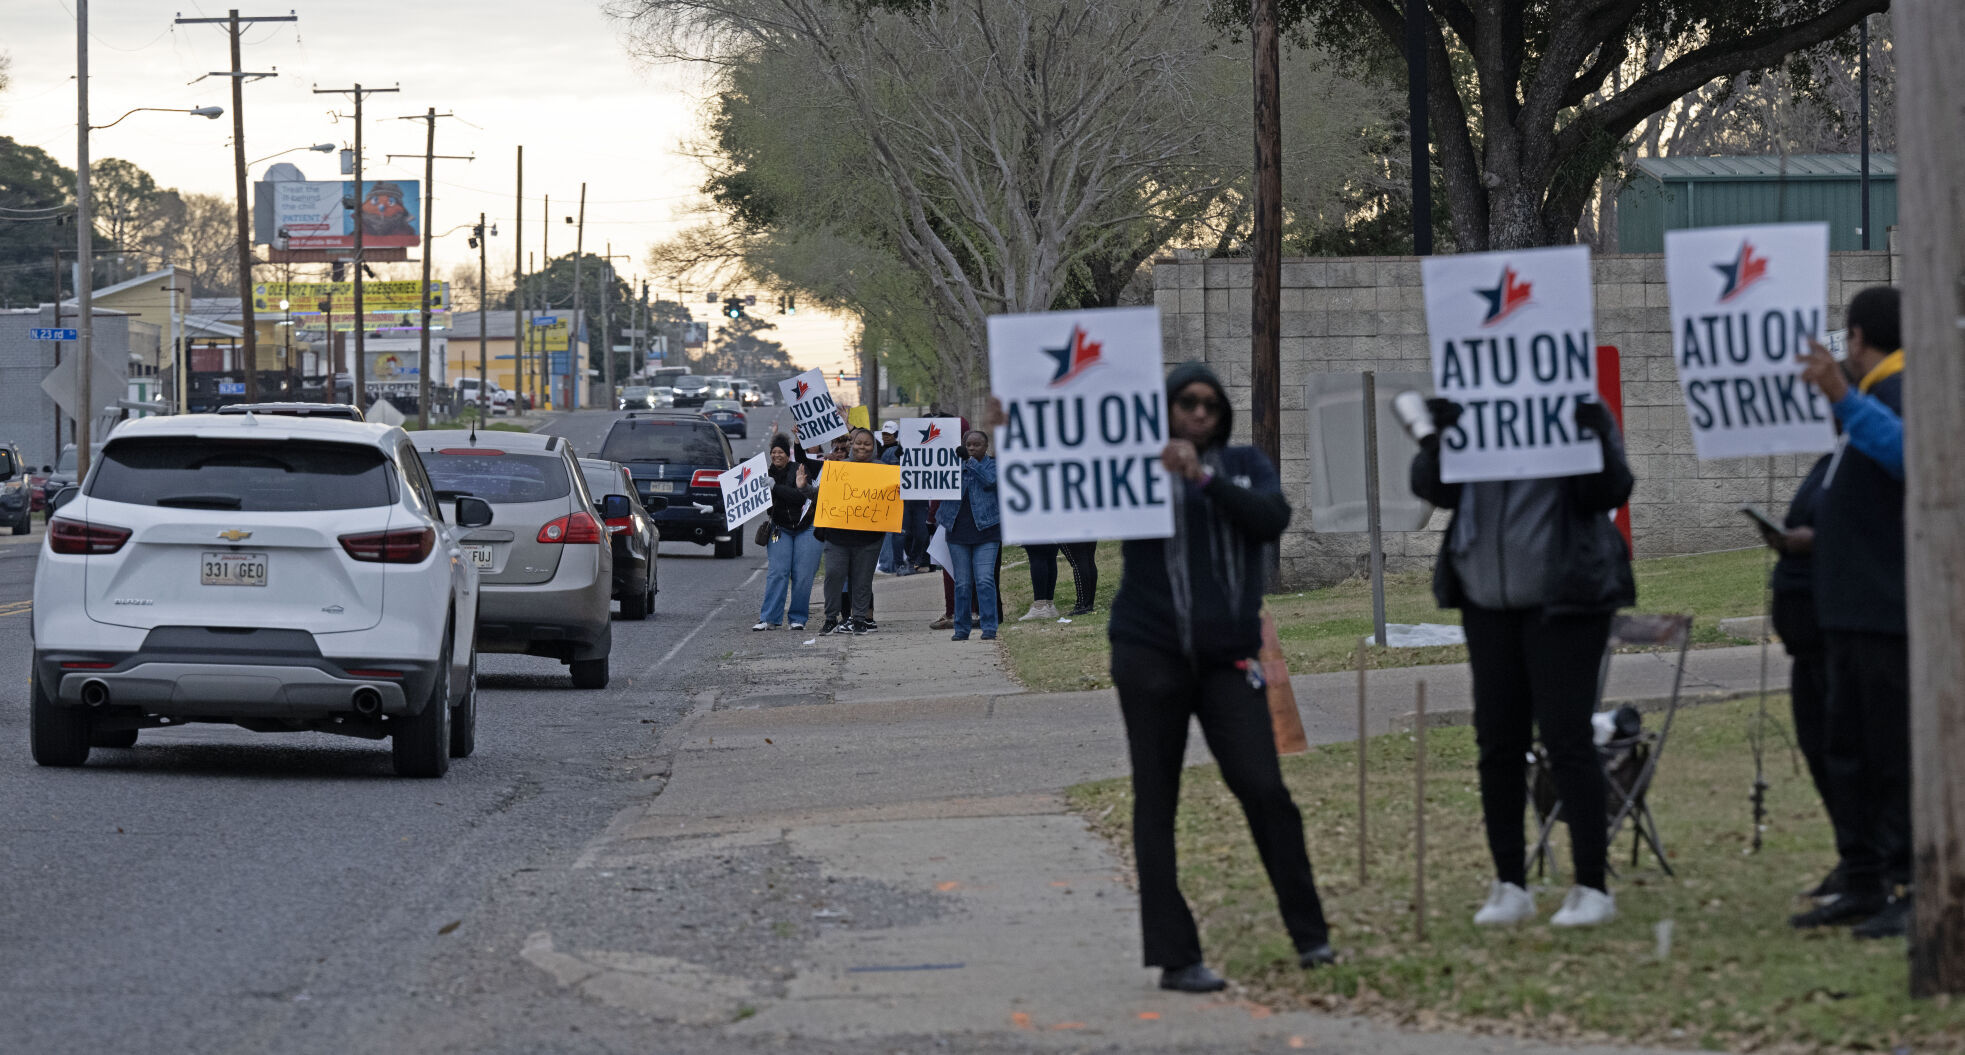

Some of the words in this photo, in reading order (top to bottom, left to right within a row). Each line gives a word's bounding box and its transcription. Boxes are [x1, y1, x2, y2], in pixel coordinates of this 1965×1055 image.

[40, 329, 52, 339] 23
[54, 329, 64, 339] rd
[1681, 312, 1751, 369] ATU
[1762, 308, 1819, 363] ON
[1440, 335, 1519, 389] ATU
[1530, 330, 1591, 384] ON
[813, 392, 835, 413] ON
[1687, 373, 1826, 430] STRIKE
[797, 410, 844, 441] STRIKE
[1002, 394, 1085, 451] ATU
[1099, 390, 1163, 445] ON
[826, 462, 849, 482] We
[902, 447, 932, 467] ATU
[937, 447, 960, 467] ON
[726, 481, 749, 509] ATU
[751, 472, 769, 492] ON
[901, 470, 960, 490] STRIKE
[1005, 454, 1166, 513] STRIKE
[727, 487, 771, 523] STRIKE
[206, 561, 229, 578] 331
[239, 562, 264, 579] GEO
[472, 550, 491, 563] FUJ
